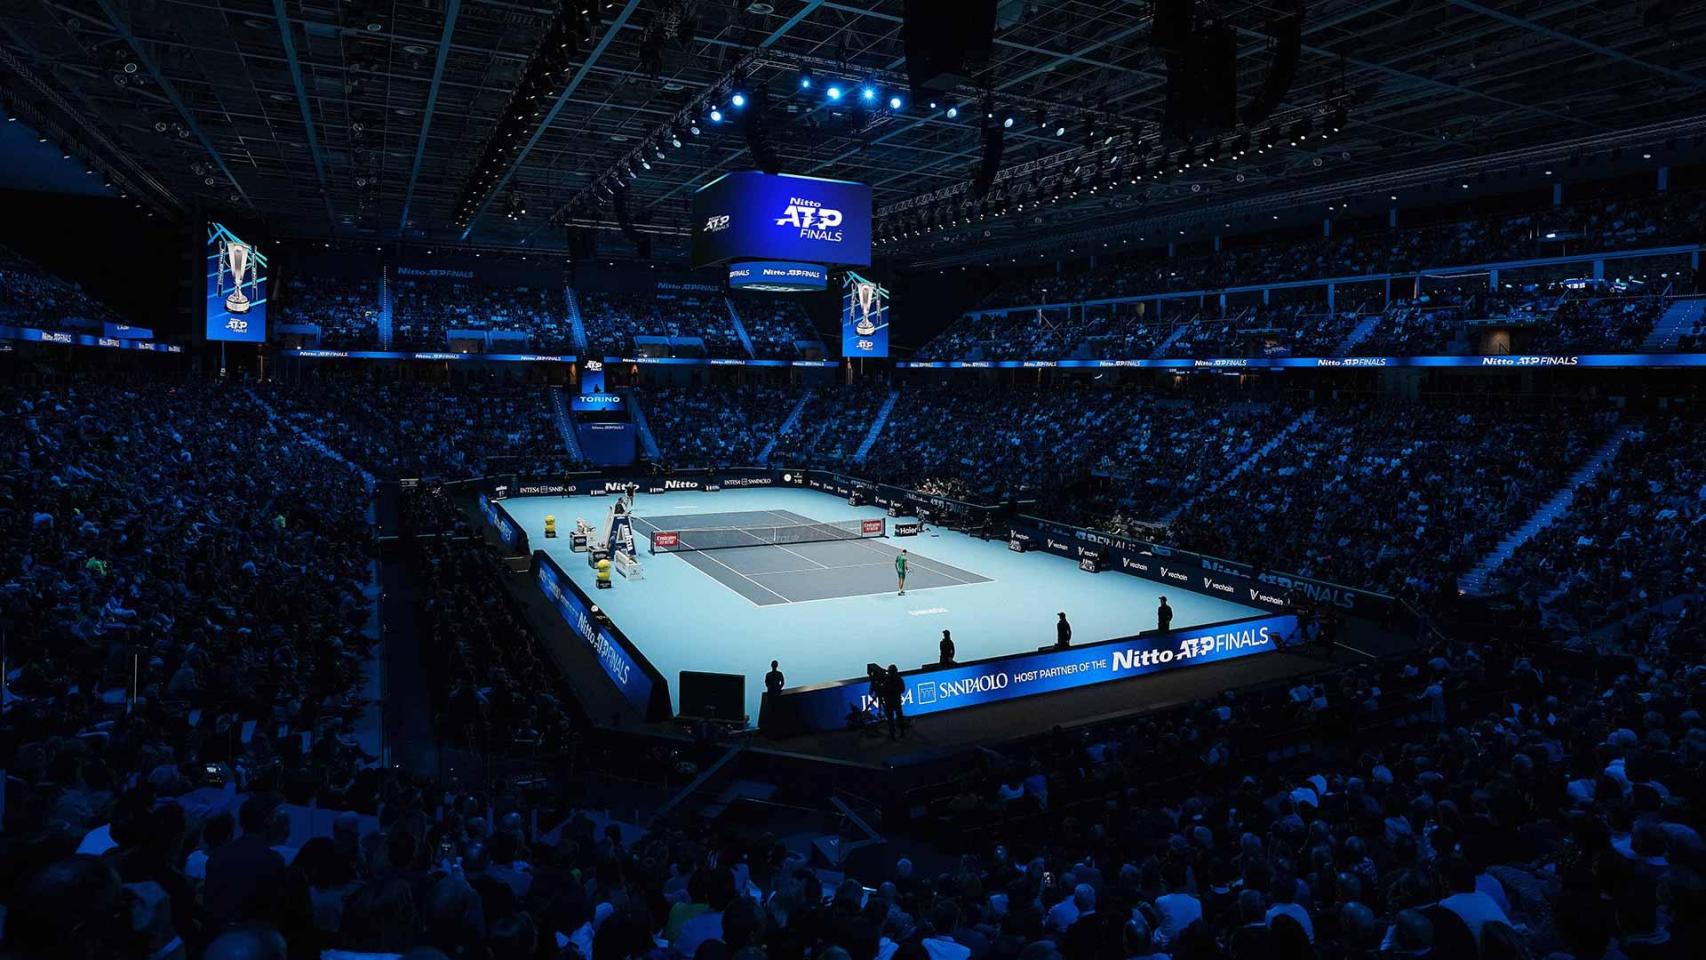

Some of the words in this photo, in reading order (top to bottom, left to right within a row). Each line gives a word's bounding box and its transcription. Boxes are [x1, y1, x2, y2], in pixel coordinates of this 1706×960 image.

[790, 196, 821, 207] Nitto
[774, 205, 842, 230] ATP
[800, 229, 842, 242] FINALS
[1482, 357, 1514, 365] Nitto
[548, 485, 577, 493] SANPLO
[664, 480, 698, 489] Nitto
[900, 526, 917, 535] Haier
[1213, 583, 1234, 593] vechain
[1259, 593, 1284, 606] vechain
[577, 611, 596, 644] Nitto
[861, 688, 914, 712] INA
[939, 673, 1008, 699] SANPAOLO
[1013, 670, 1039, 684] HOST
[1039, 664, 1078, 680] PARTNER
[1079, 661, 1092, 672] OF
[1092, 659, 1107, 670] THE
[1112, 649, 1174, 672] Nitto
